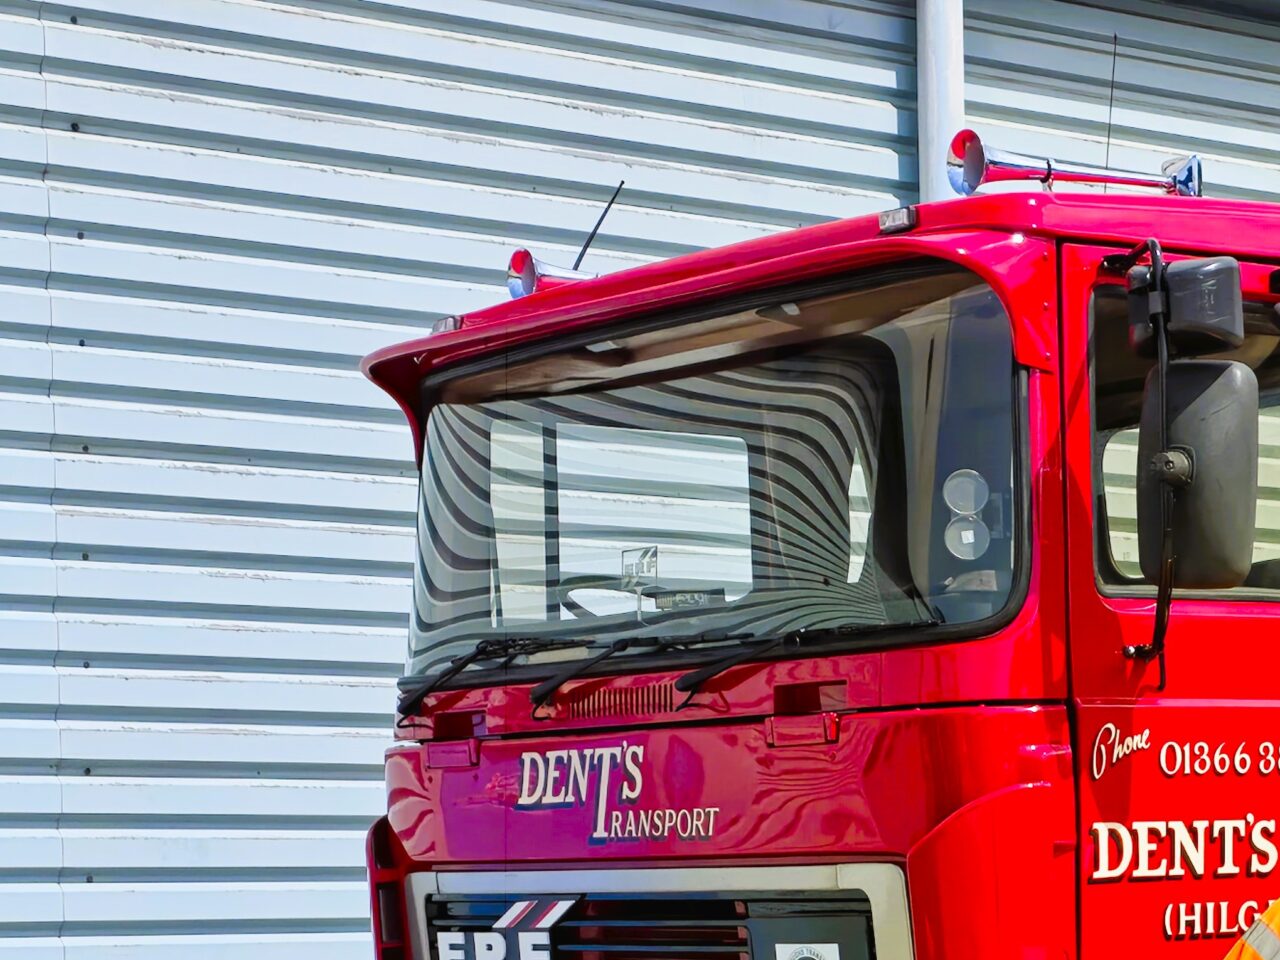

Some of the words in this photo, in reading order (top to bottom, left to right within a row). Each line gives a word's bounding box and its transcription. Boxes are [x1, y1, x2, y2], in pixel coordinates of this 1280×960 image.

[1092, 722, 1151, 780] Phone
[1159, 740, 1251, 775] 01366
[517, 740, 645, 838] DENT'S
[1091, 812, 1279, 880] DENT'S
[1163, 900, 1276, 936] (HILG
